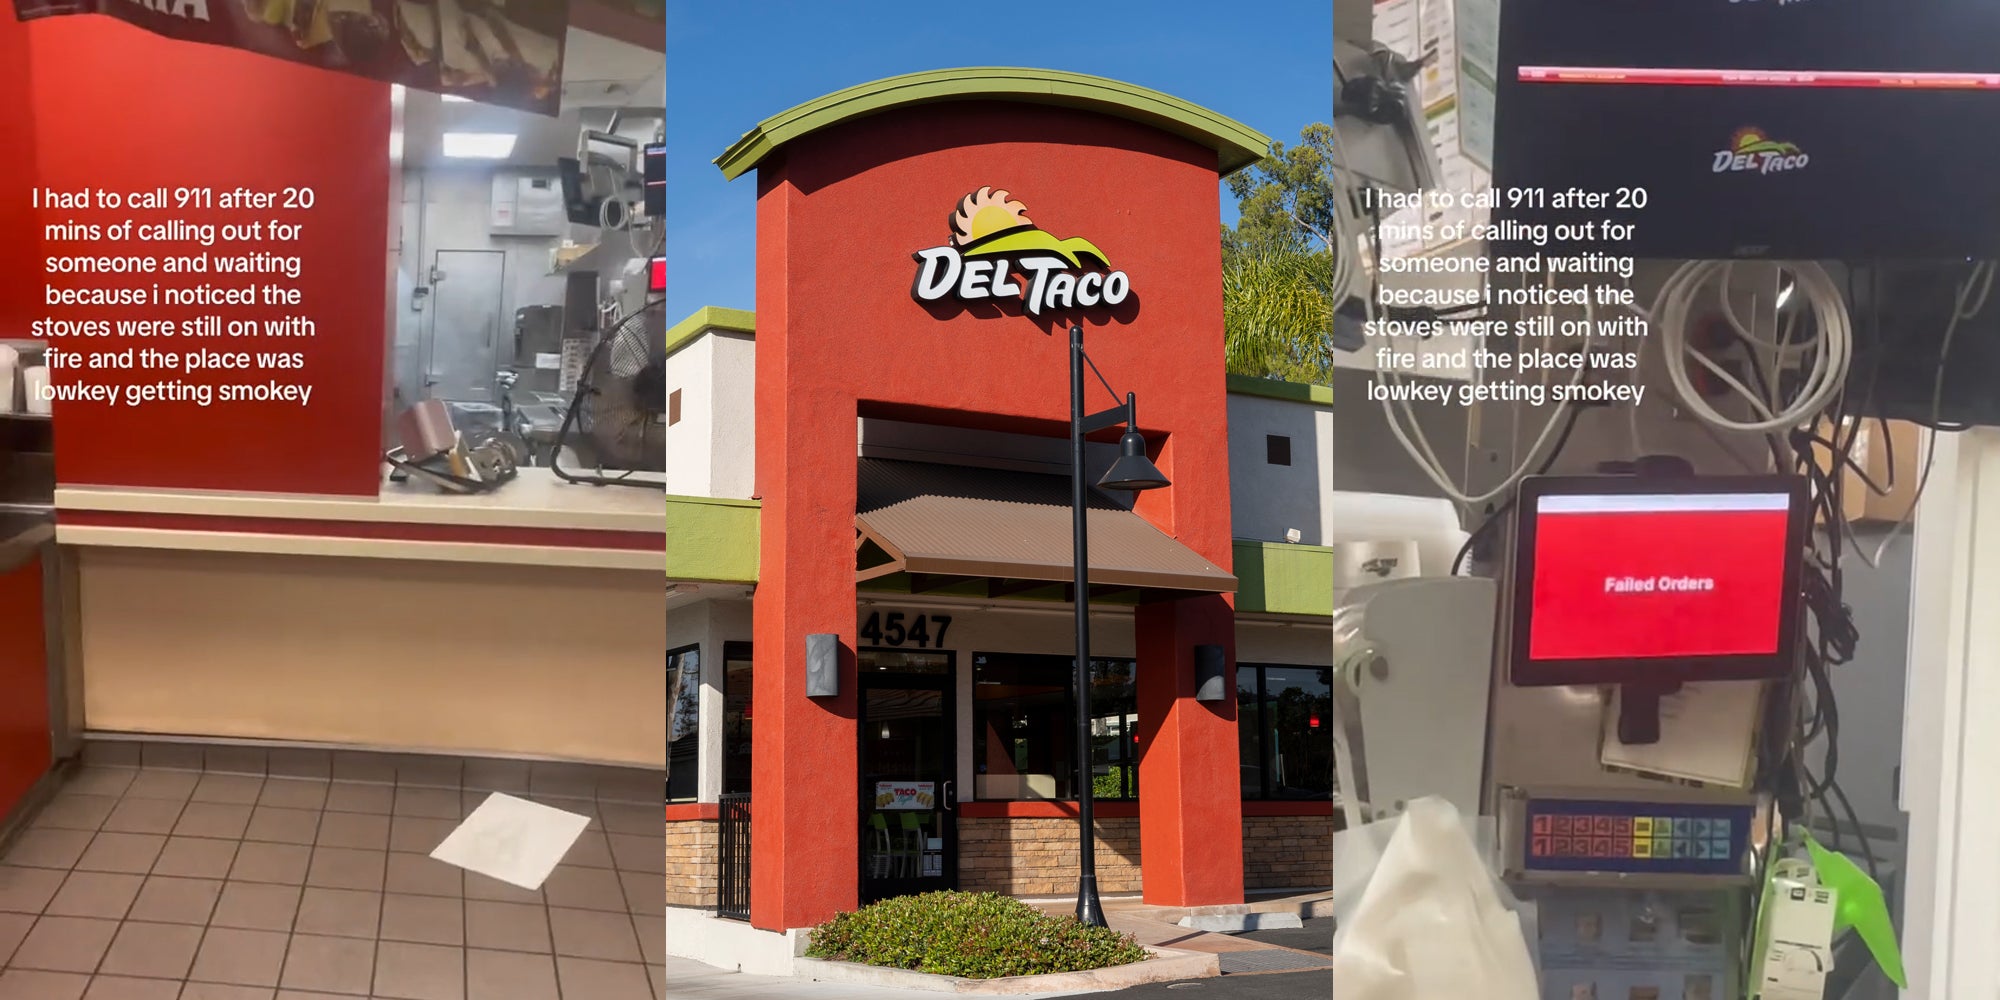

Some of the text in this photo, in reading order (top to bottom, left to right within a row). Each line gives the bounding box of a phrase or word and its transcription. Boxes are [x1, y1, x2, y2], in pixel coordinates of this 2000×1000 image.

[1712, 150, 1809, 176] DEL TACO
[915, 246, 1130, 316] DEL TACO
[1604, 576, 1715, 592] Failed Orders
[861, 611, 953, 648] 4547
[894, 788, 917, 797] TACO
